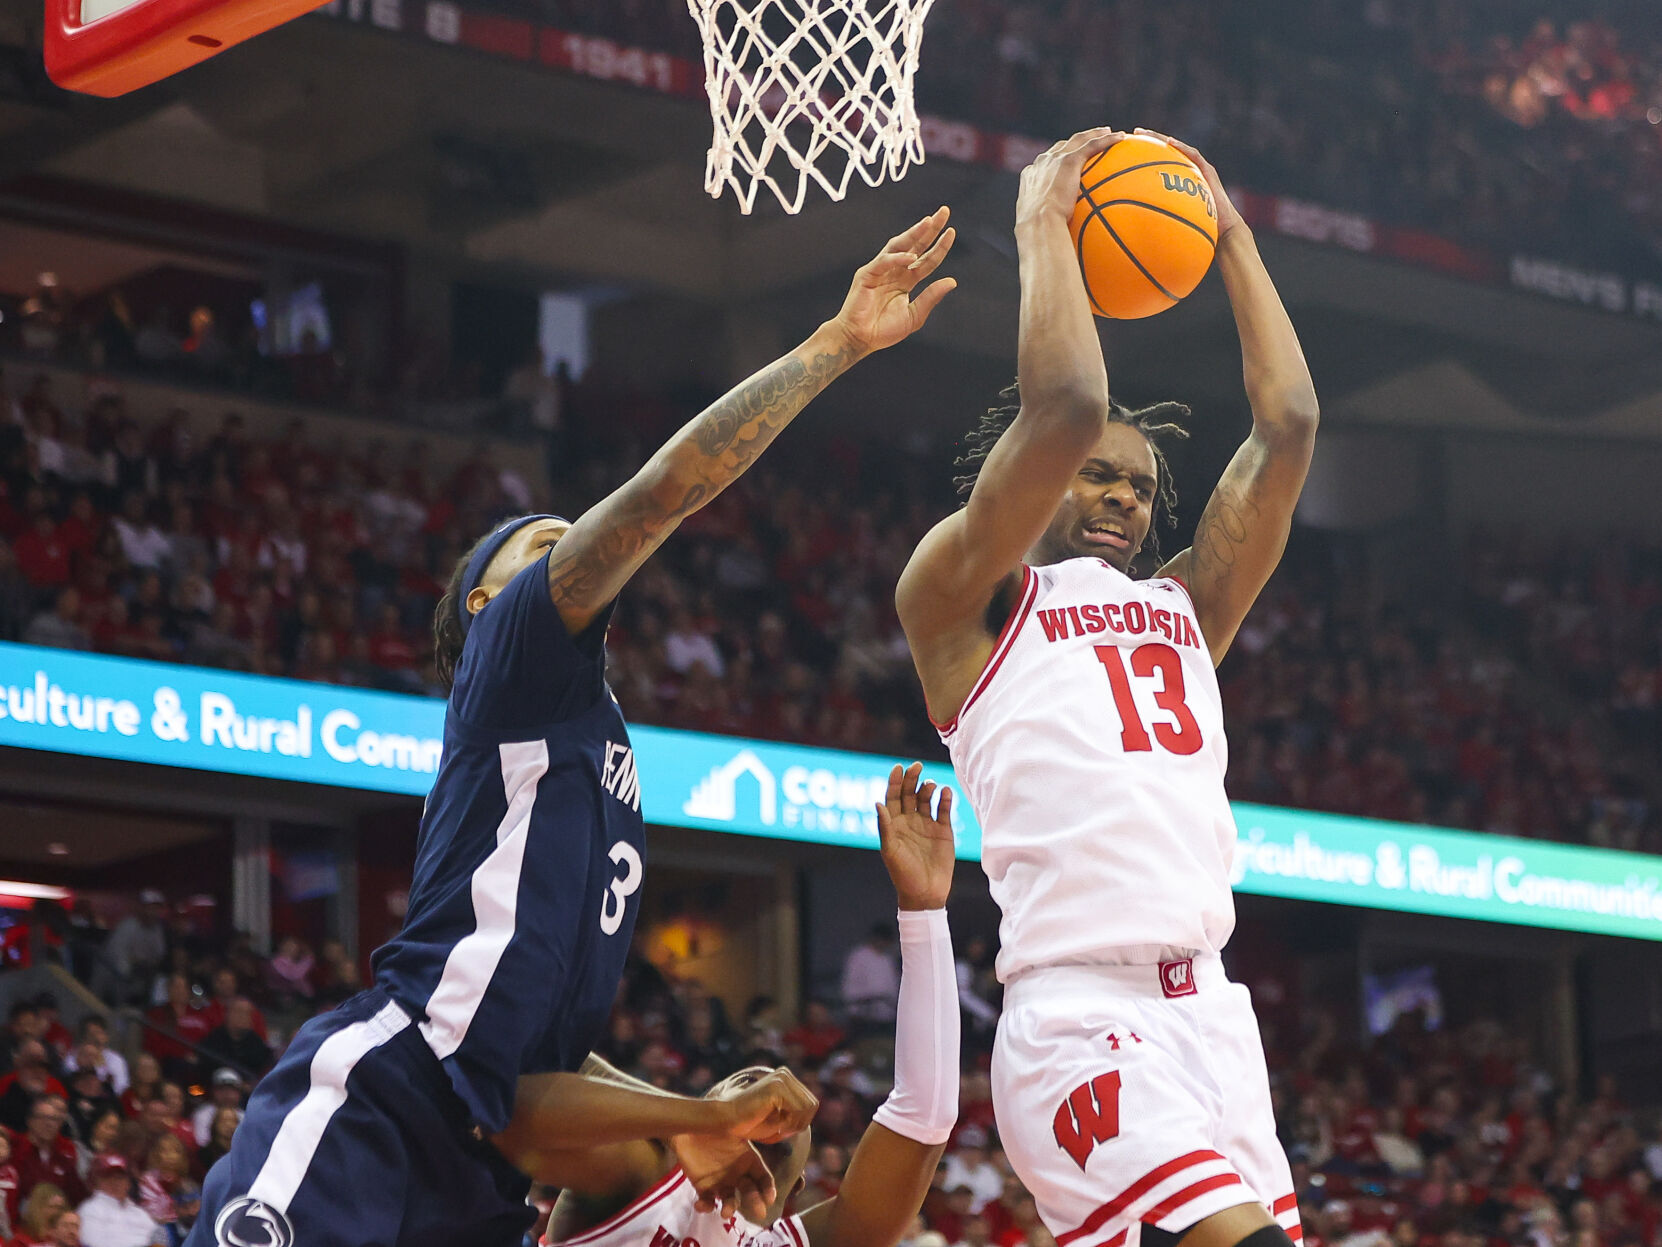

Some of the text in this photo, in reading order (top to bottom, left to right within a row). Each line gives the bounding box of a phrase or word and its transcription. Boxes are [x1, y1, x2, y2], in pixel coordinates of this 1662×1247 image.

[560, 34, 672, 91] 1941
[1037, 601, 1200, 649] WISCONSIN
[152, 687, 189, 742] &
[201, 691, 312, 758] Rural
[1094, 643, 1203, 755] 13
[600, 841, 643, 936] 3
[1376, 841, 1408, 890] &
[1409, 844, 1493, 900] Rural
[1168, 963, 1189, 989] W
[1053, 1070, 1121, 1173] W
